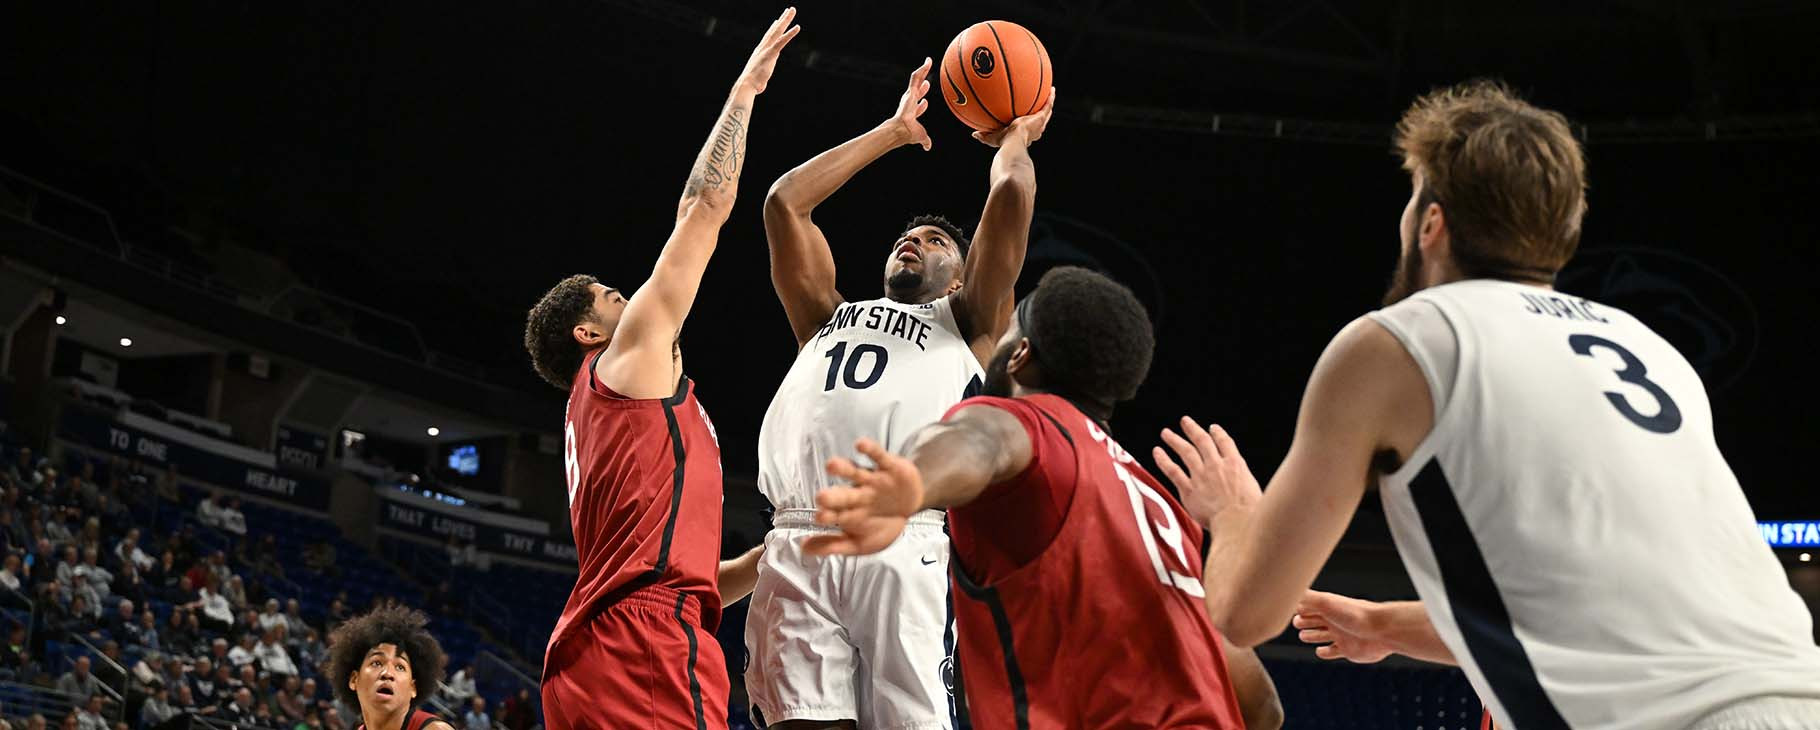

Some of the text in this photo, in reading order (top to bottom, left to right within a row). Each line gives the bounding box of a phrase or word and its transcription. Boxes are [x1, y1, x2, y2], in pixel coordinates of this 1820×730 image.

[865, 306, 932, 352] STATE
[824, 341, 889, 391] 10
[1568, 333, 1682, 434] 3
[110, 429, 168, 462] TO ONE
[246, 471, 297, 495] HEART
[390, 505, 424, 526] THAT
[504, 532, 577, 560] THY NAM
[1781, 523, 1820, 544] STA
